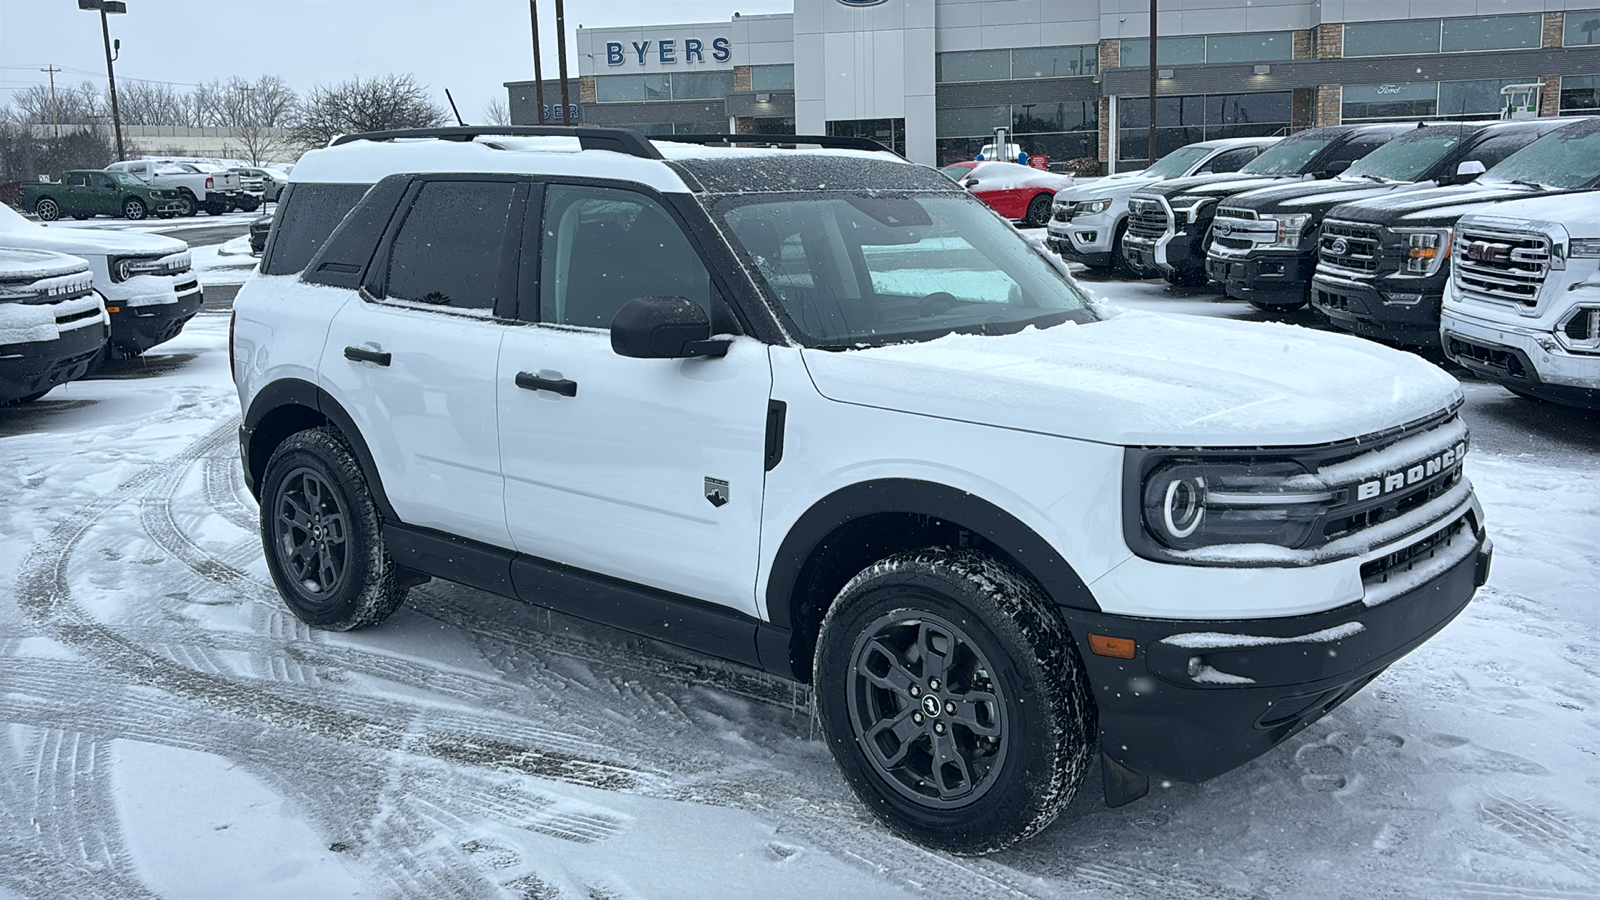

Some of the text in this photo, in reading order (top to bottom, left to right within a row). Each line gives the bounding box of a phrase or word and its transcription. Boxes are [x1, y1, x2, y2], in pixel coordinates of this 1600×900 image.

[606, 37, 732, 65] BYERS
[1377, 84, 1401, 94] Ford
[1467, 243, 1507, 262] GMC
[1357, 442, 1466, 501] BRONCO
